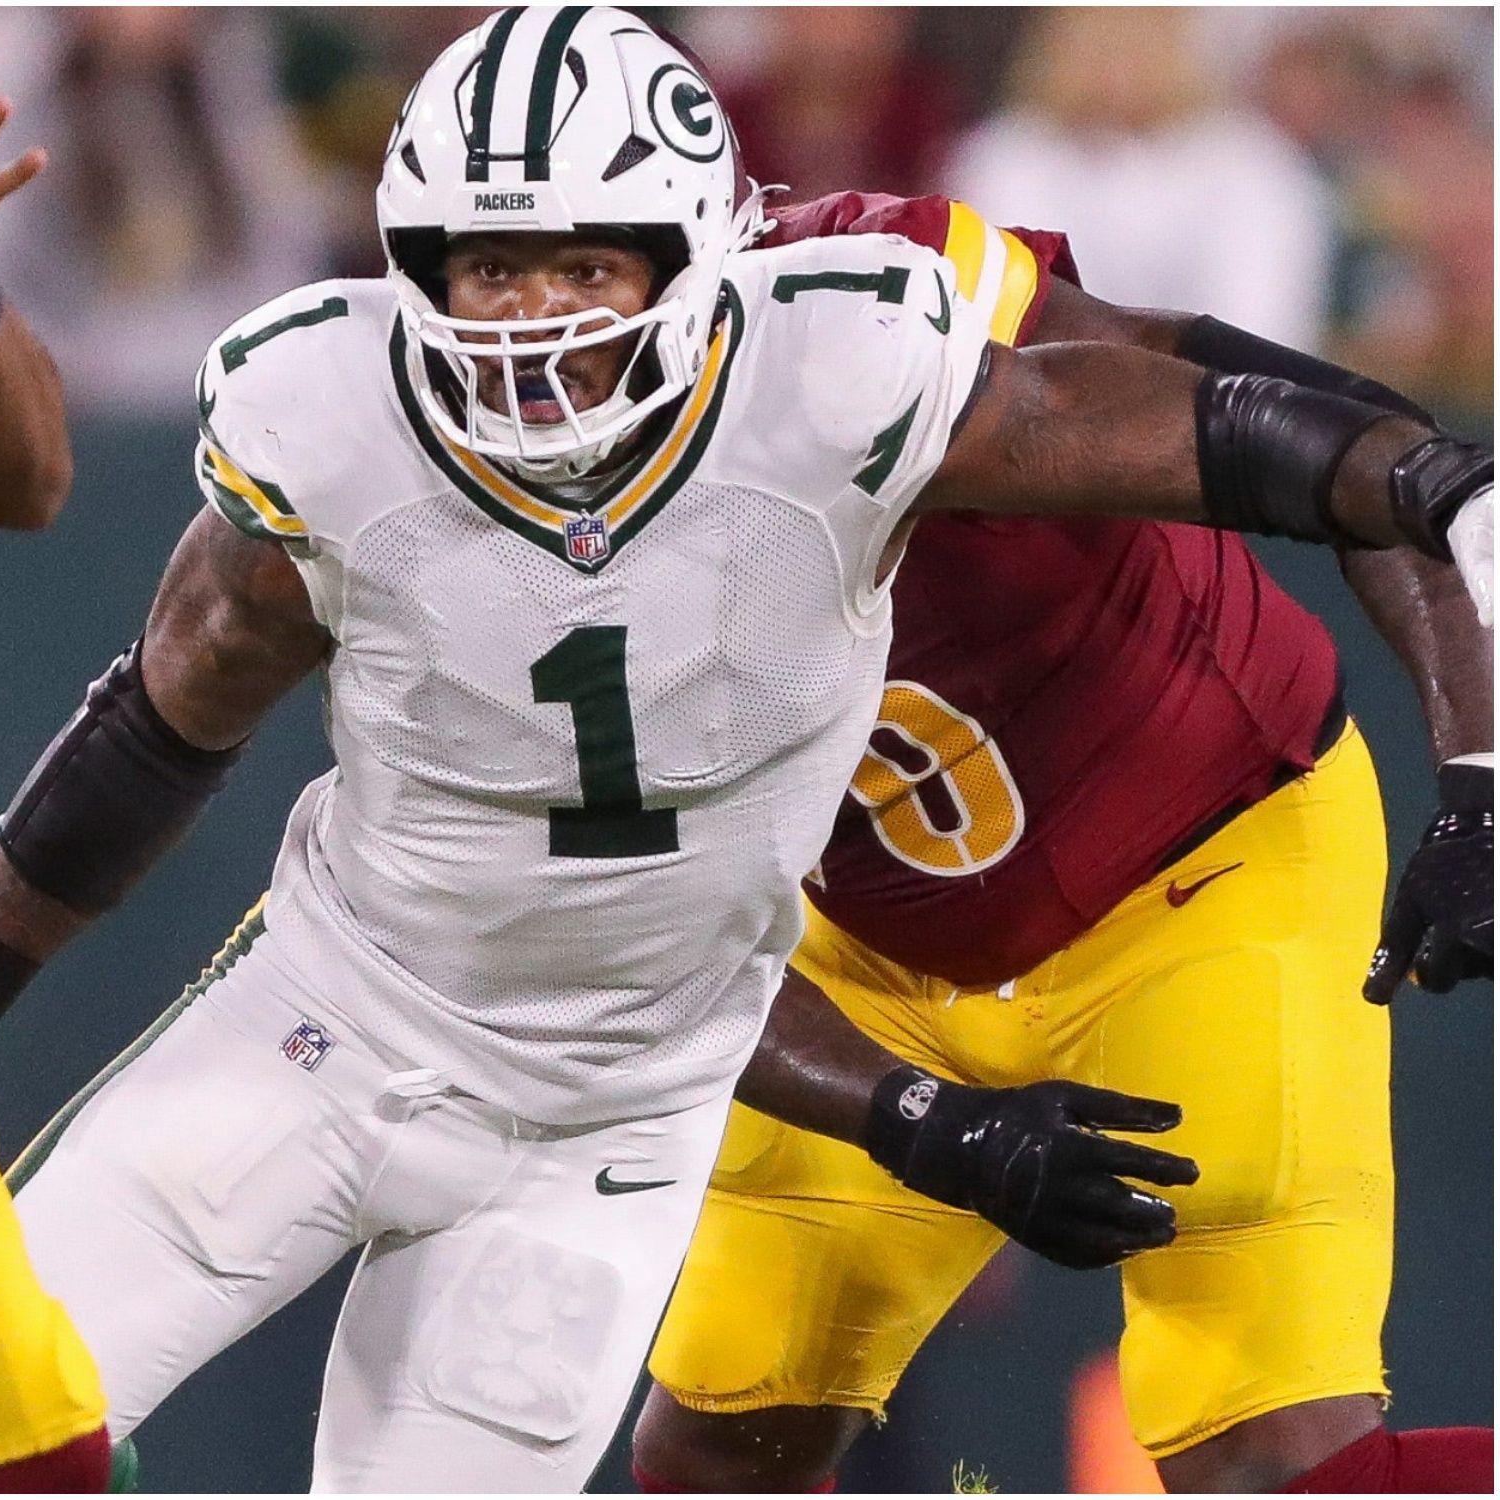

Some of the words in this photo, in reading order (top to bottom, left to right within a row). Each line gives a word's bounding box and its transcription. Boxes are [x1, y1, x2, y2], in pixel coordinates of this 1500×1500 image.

[474, 192, 535, 212] PACKERS
[771, 266, 911, 305] 1
[220, 296, 349, 375] 1
[572, 536, 604, 557] NFL
[529, 624, 681, 858] 1
[802, 679, 1026, 878] 0
[285, 1036, 315, 1066] NFL
